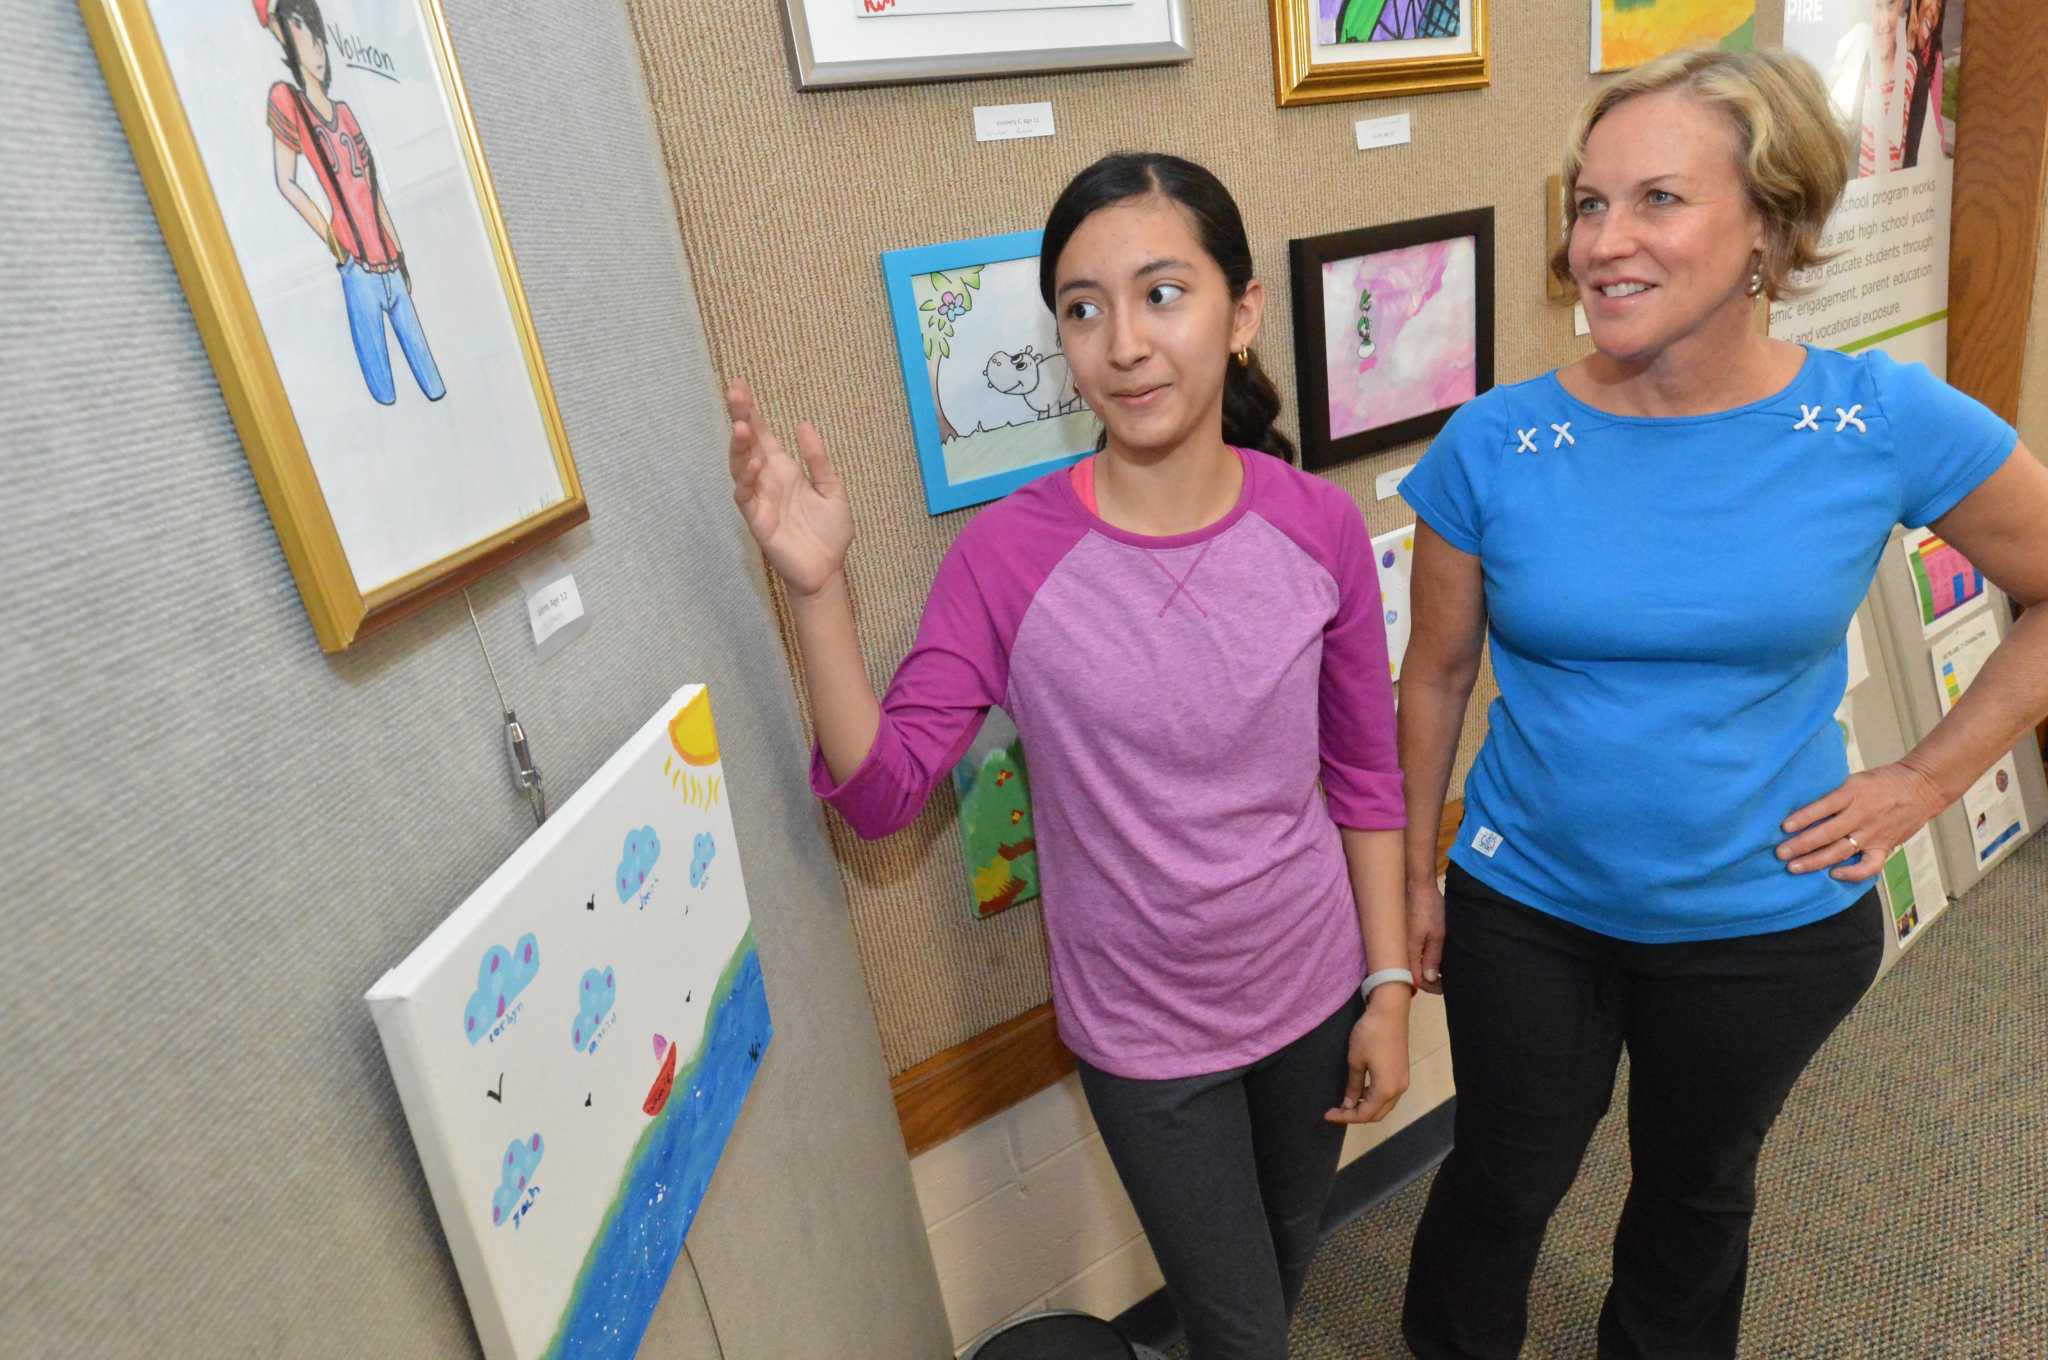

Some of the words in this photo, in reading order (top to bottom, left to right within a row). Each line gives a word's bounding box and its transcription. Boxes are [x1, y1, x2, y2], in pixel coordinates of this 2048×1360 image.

[1872, 186, 1909, 208] program
[1912, 178, 1936, 198] works
[1837, 224, 1855, 243] and
[1859, 219, 1878, 240] high
[1881, 209, 1908, 232] school
[1805, 265, 1824, 283] and
[1826, 254, 1863, 277] educate
[1865, 244, 1900, 267] students
[1862, 275, 1889, 299] parent
[1815, 311, 1861, 340] vocational
